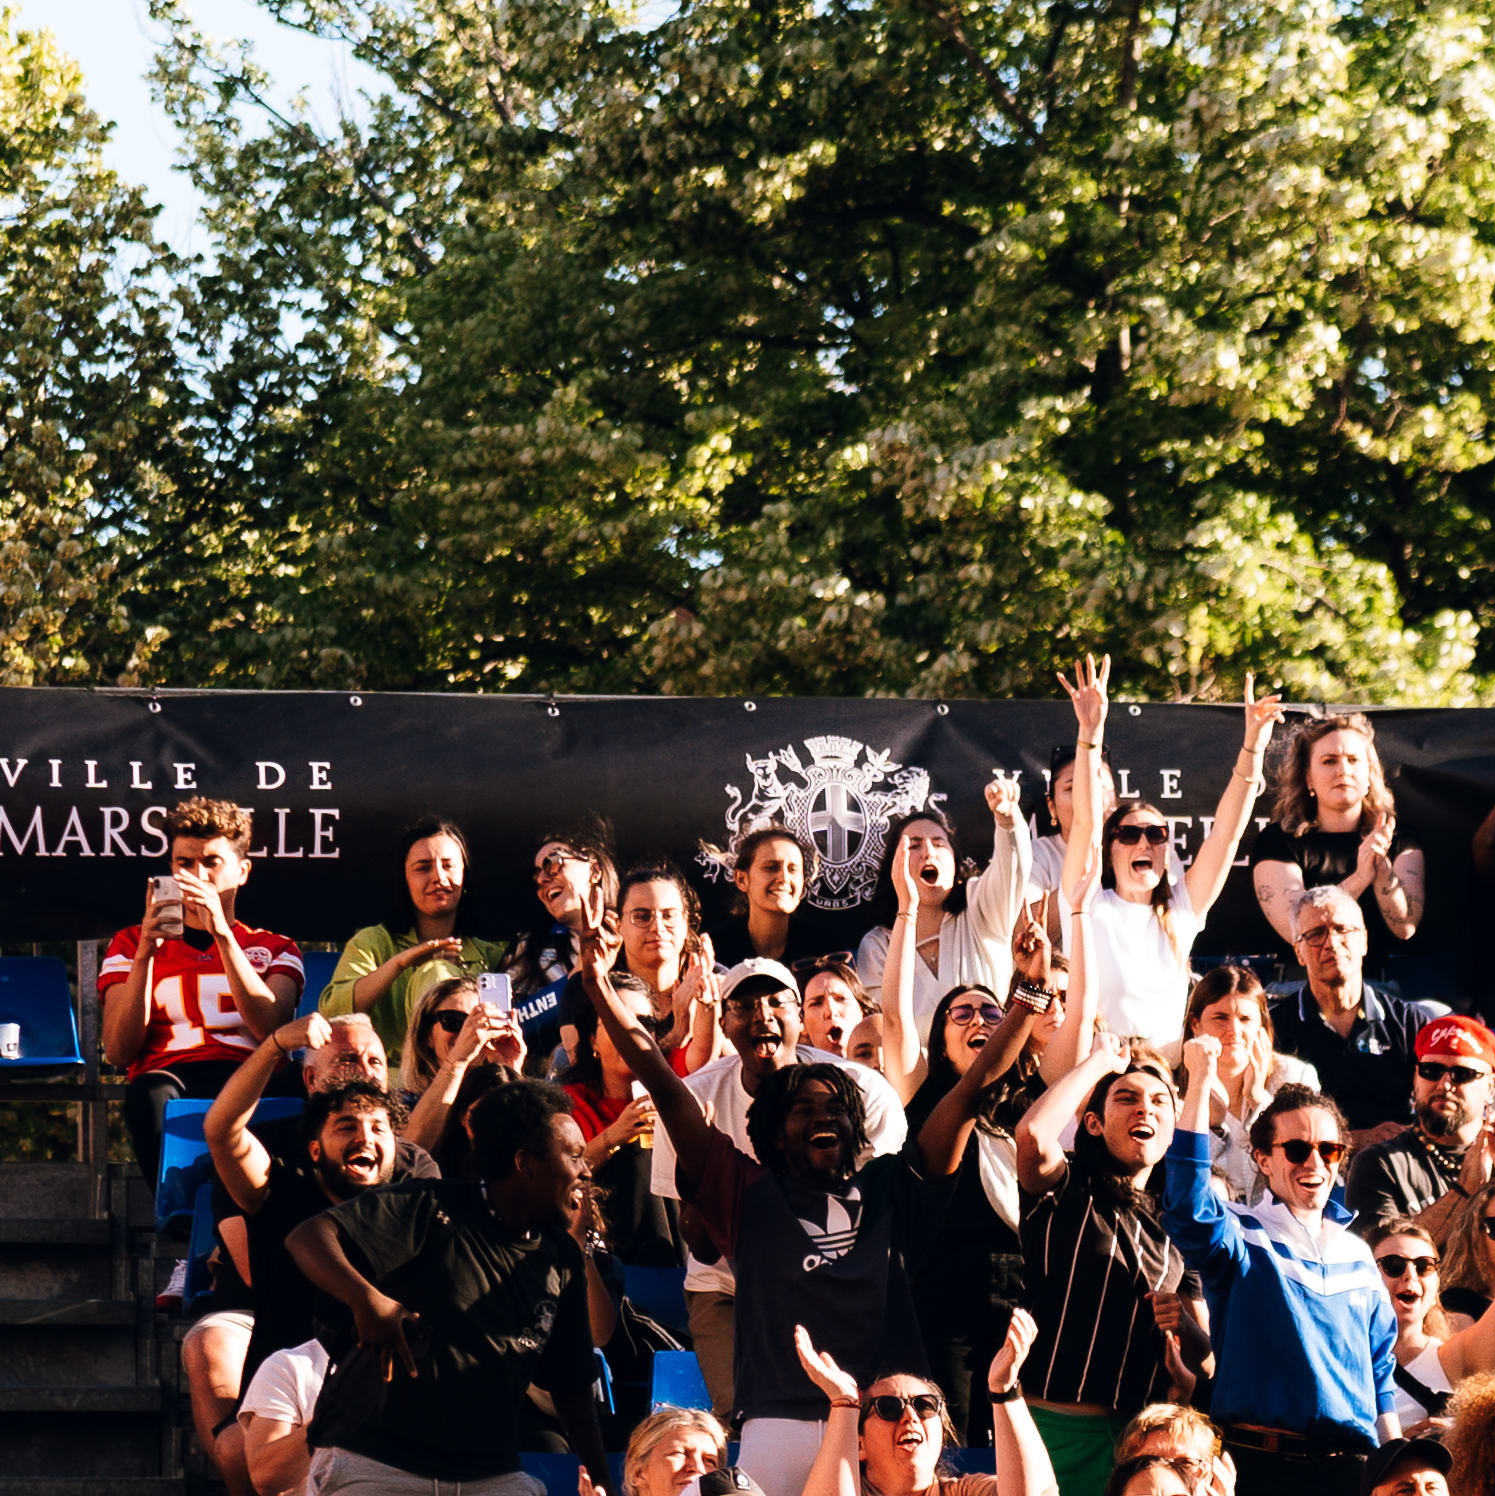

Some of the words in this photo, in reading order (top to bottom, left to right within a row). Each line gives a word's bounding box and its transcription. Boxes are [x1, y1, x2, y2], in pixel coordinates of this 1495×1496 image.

[0, 758, 197, 789] VILLE
[256, 762, 332, 790] DE
[0, 804, 340, 858] MARSLE
